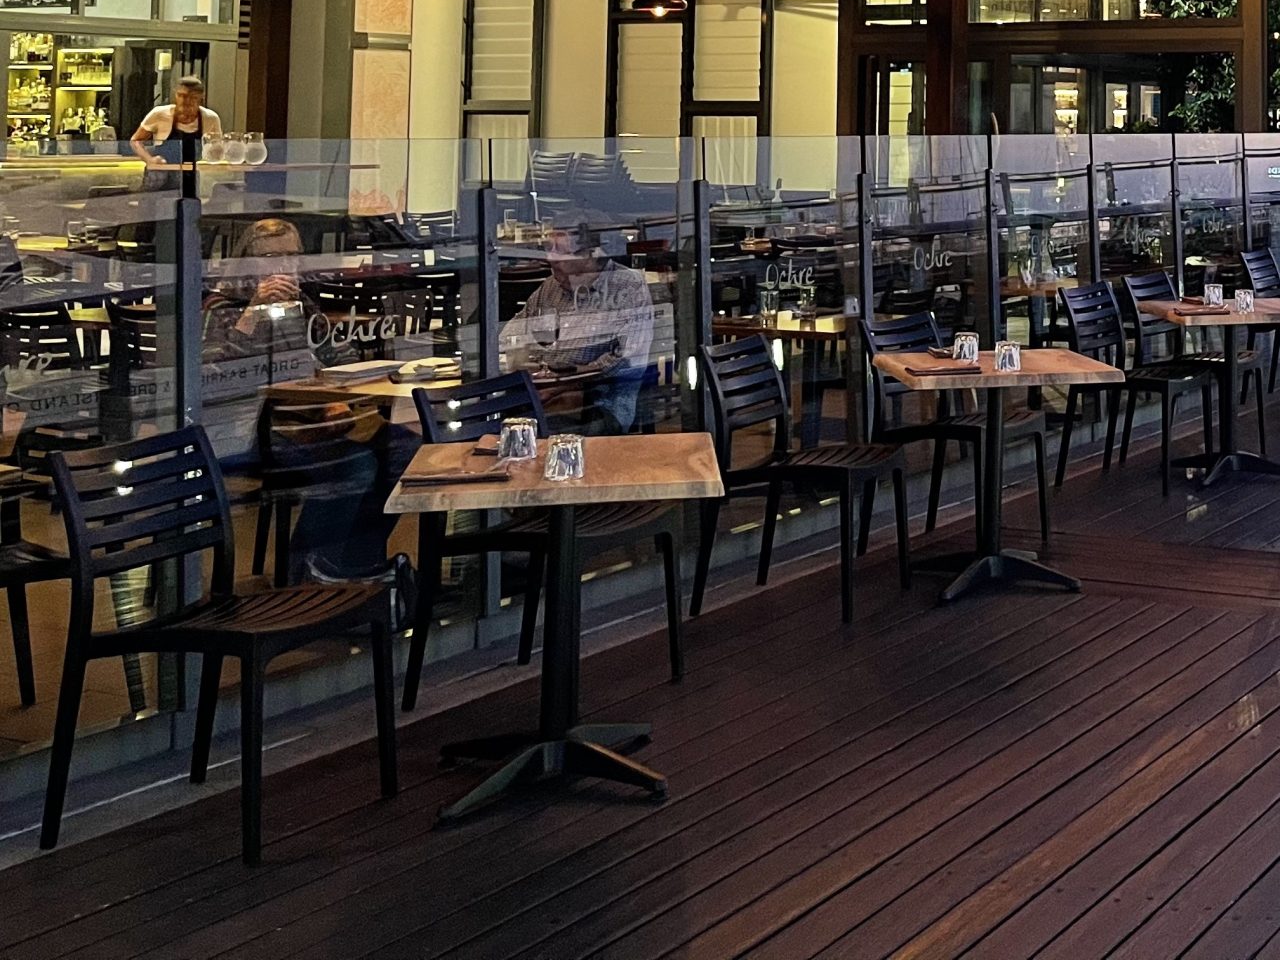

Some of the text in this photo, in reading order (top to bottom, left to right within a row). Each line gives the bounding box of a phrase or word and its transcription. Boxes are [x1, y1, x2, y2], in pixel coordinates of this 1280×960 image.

[913, 240, 953, 271] Ochre
[765, 258, 816, 290] Ochre
[306, 305, 396, 348] Ochre
